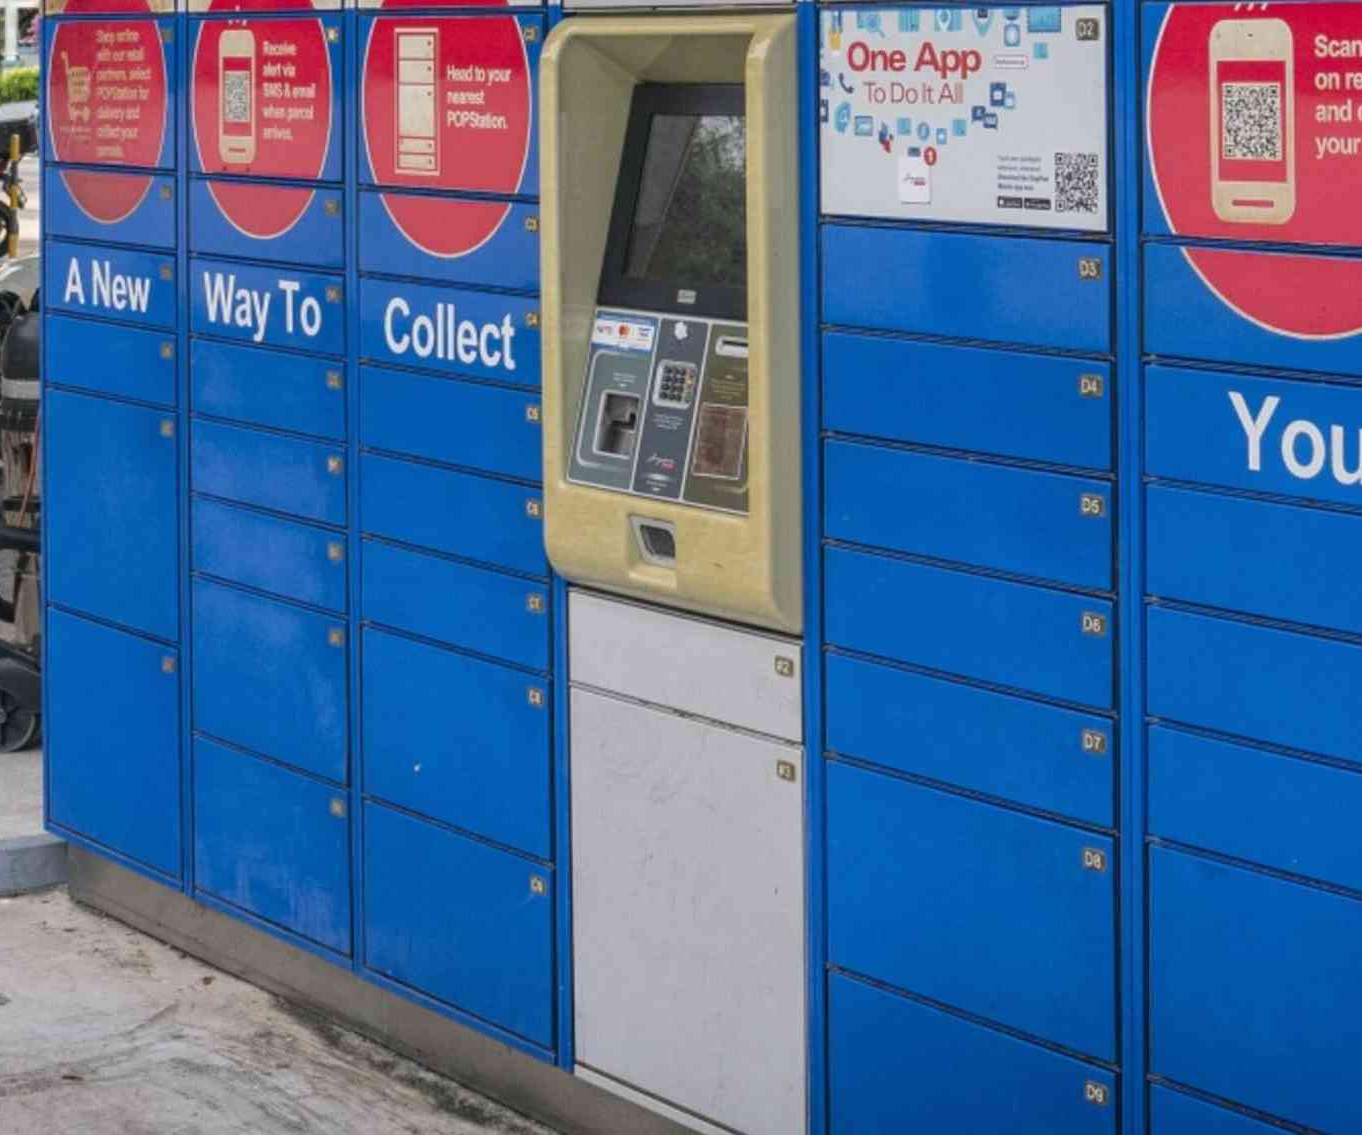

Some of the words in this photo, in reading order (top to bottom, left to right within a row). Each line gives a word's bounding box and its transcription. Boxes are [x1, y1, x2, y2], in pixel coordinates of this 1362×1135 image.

[1079, 21, 1094, 36] D2
[847, 41, 906, 71] One
[914, 41, 982, 79] App
[447, 64, 473, 82] Head
[475, 65, 485, 82] to
[487, 69, 512, 86] your
[1314, 75, 1340, 91] on
[447, 90, 485, 105] nearest
[863, 82, 886, 104] To
[890, 82, 918, 104] Do
[922, 82, 934, 104] It
[938, 82, 964, 104] All
[1315, 101, 1353, 123] and
[1315, 137, 1360, 157] your
[1080, 260, 1096, 276] D3
[64, 257, 86, 304] A
[92, 260, 150, 313] New
[204, 271, 271, 343] Way
[278, 279, 322, 336] To
[384, 296, 517, 370] Collect
[1081, 376, 1097, 393] D4
[1084, 733, 1101, 750] D7
